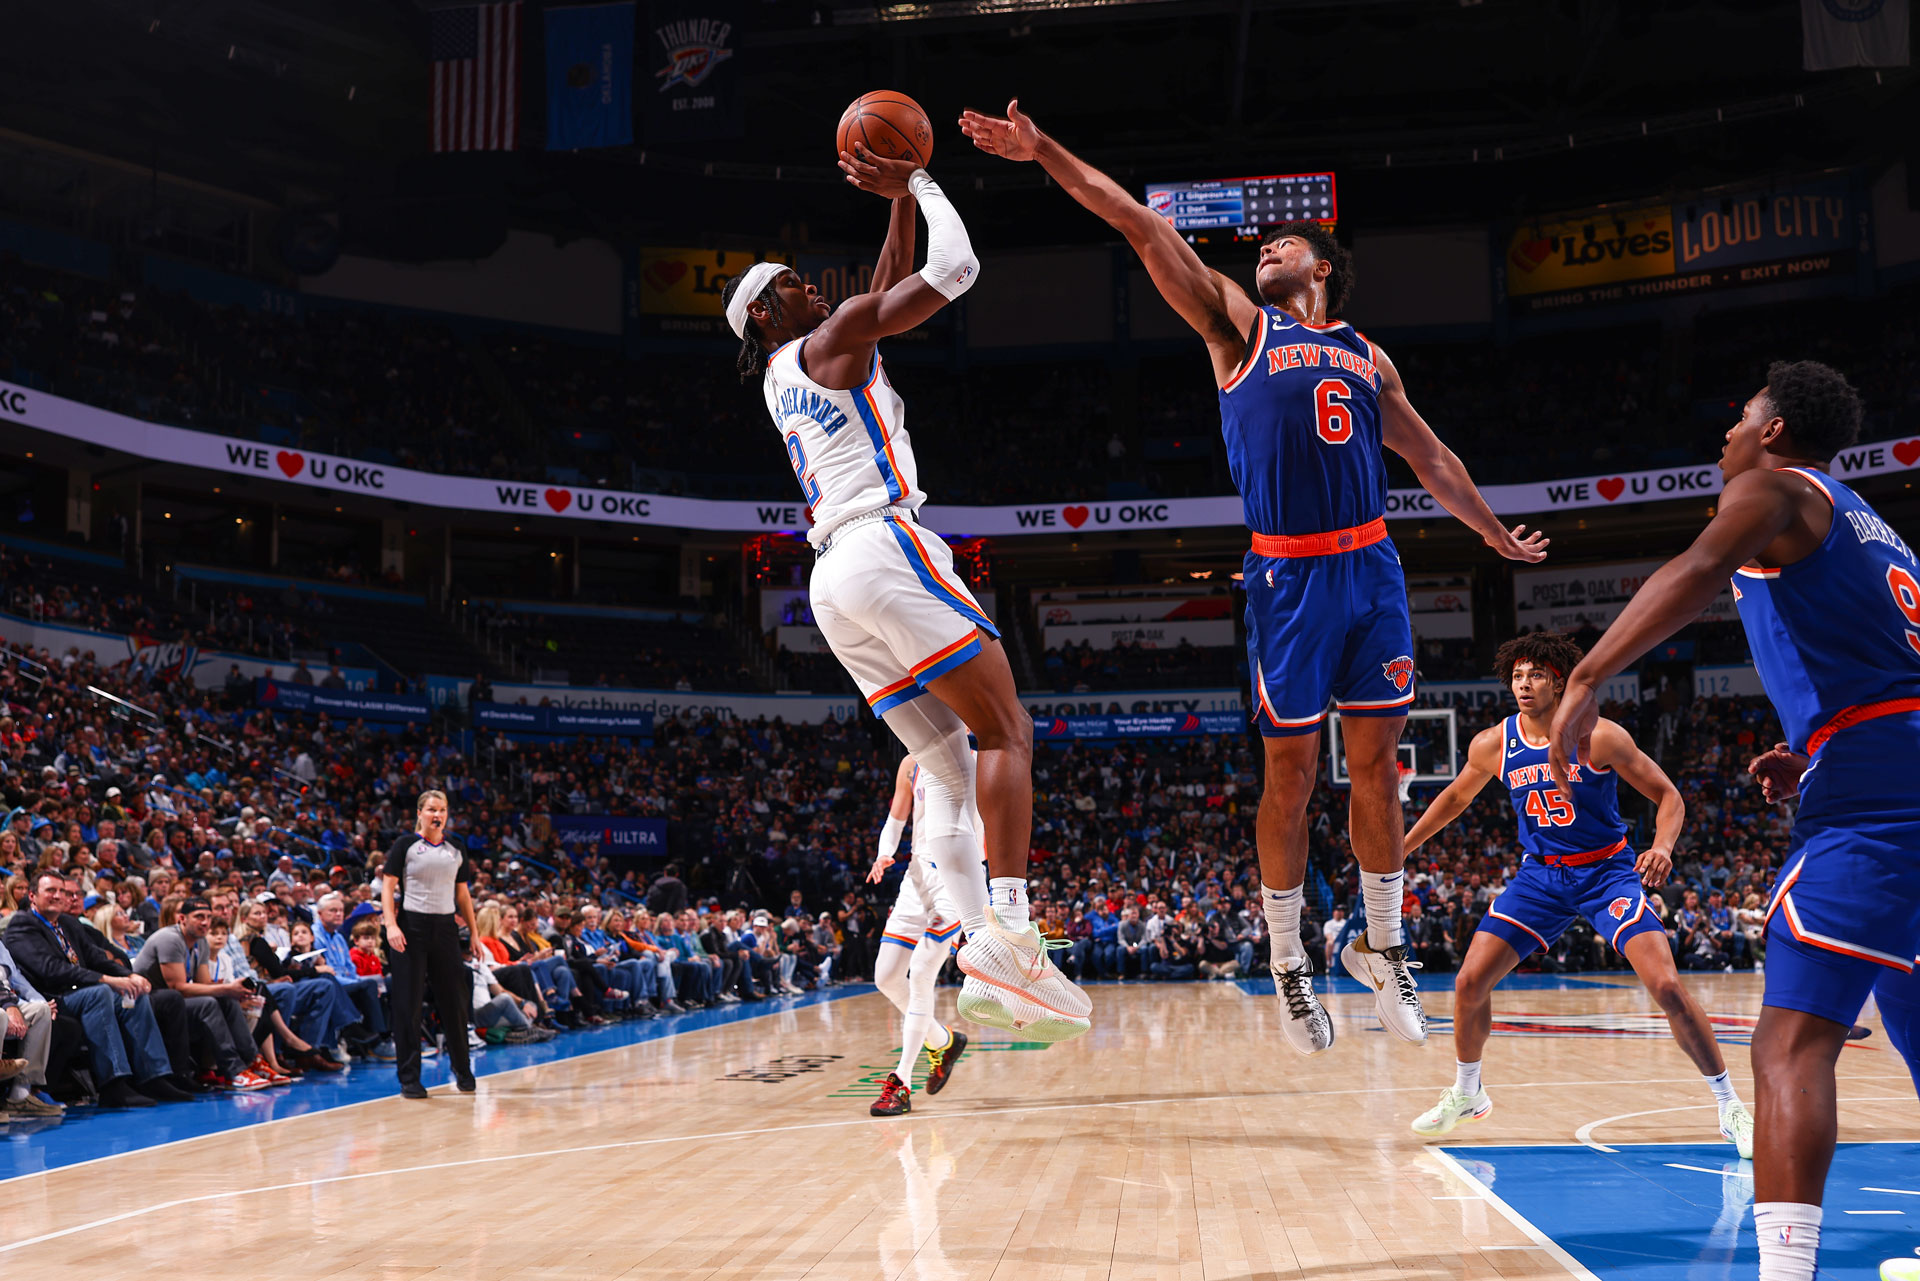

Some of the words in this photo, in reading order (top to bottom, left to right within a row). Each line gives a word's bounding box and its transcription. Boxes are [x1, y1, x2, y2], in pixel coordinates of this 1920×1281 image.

[656, 17, 732, 50] THUNDER
[672, 98, 690, 111] EST.
[1266, 186, 1274, 196] 4
[1286, 184, 1292, 195] 1
[1321, 183, 1327, 193] 1
[1186, 204, 1207, 213] Dort
[1187, 216, 1218, 225] Waters
[1681, 200, 1762, 265] LOUD
[1773, 195, 1845, 240] CITY
[1531, 290, 1584, 310] BRING
[1591, 286, 1627, 301] THE
[1628, 274, 1713, 296] THUNDER
[1740, 263, 1784, 281] EXIT
[1788, 257, 1831, 275] NOW
[1266, 343, 1322, 377] NEW
[1323, 346, 1378, 392] YORK
[1313, 378, 1354, 444] 6
[226, 444, 269, 470] WE
[310, 459, 326, 479] U
[334, 465, 384, 489] OKC
[1840, 447, 1885, 472] WE
[786, 431, 824, 511] 2
[1547, 484, 1590, 503] WE
[1631, 477, 1649, 496] U
[1658, 471, 1713, 492] OKC
[497, 487, 537, 507] WE
[578, 494, 593, 511] U
[602, 496, 650, 517] OKC
[757, 507, 797, 524] WE
[1017, 510, 1056, 527] WE
[1095, 507, 1110, 523] U
[1119, 504, 1168, 522] OKC
[1532, 583, 1566, 601] POST
[1587, 579, 1616, 596] OAK
[1886, 563, 1920, 656] 9
[1551, 614, 1573, 627] POST
[1111, 630, 1134, 644] POST
[1146, 629, 1165, 641] OAK
[1386, 659, 1413, 676] KNICKS
[1608, 684, 1637, 700] 111
[1699, 676, 1730, 693] 112
[313, 695, 344, 707] Discover
[344, 699, 358, 708] the
[359, 701, 384, 711] LASIK
[385, 702, 427, 714] Difference
[1131, 699, 1200, 714] CITY
[557, 715, 577, 724] Visit
[1126, 725, 1143, 733] Our
[1144, 724, 1173, 733] Priority
[1133, 718, 1149, 726] Eye
[1149, 717, 1176, 725] Health
[1510, 738, 1517, 748] 6
[1507, 764, 1539, 790] NEW
[1525, 789, 1577, 828] 45
[612, 831, 658, 845] ULTRA
